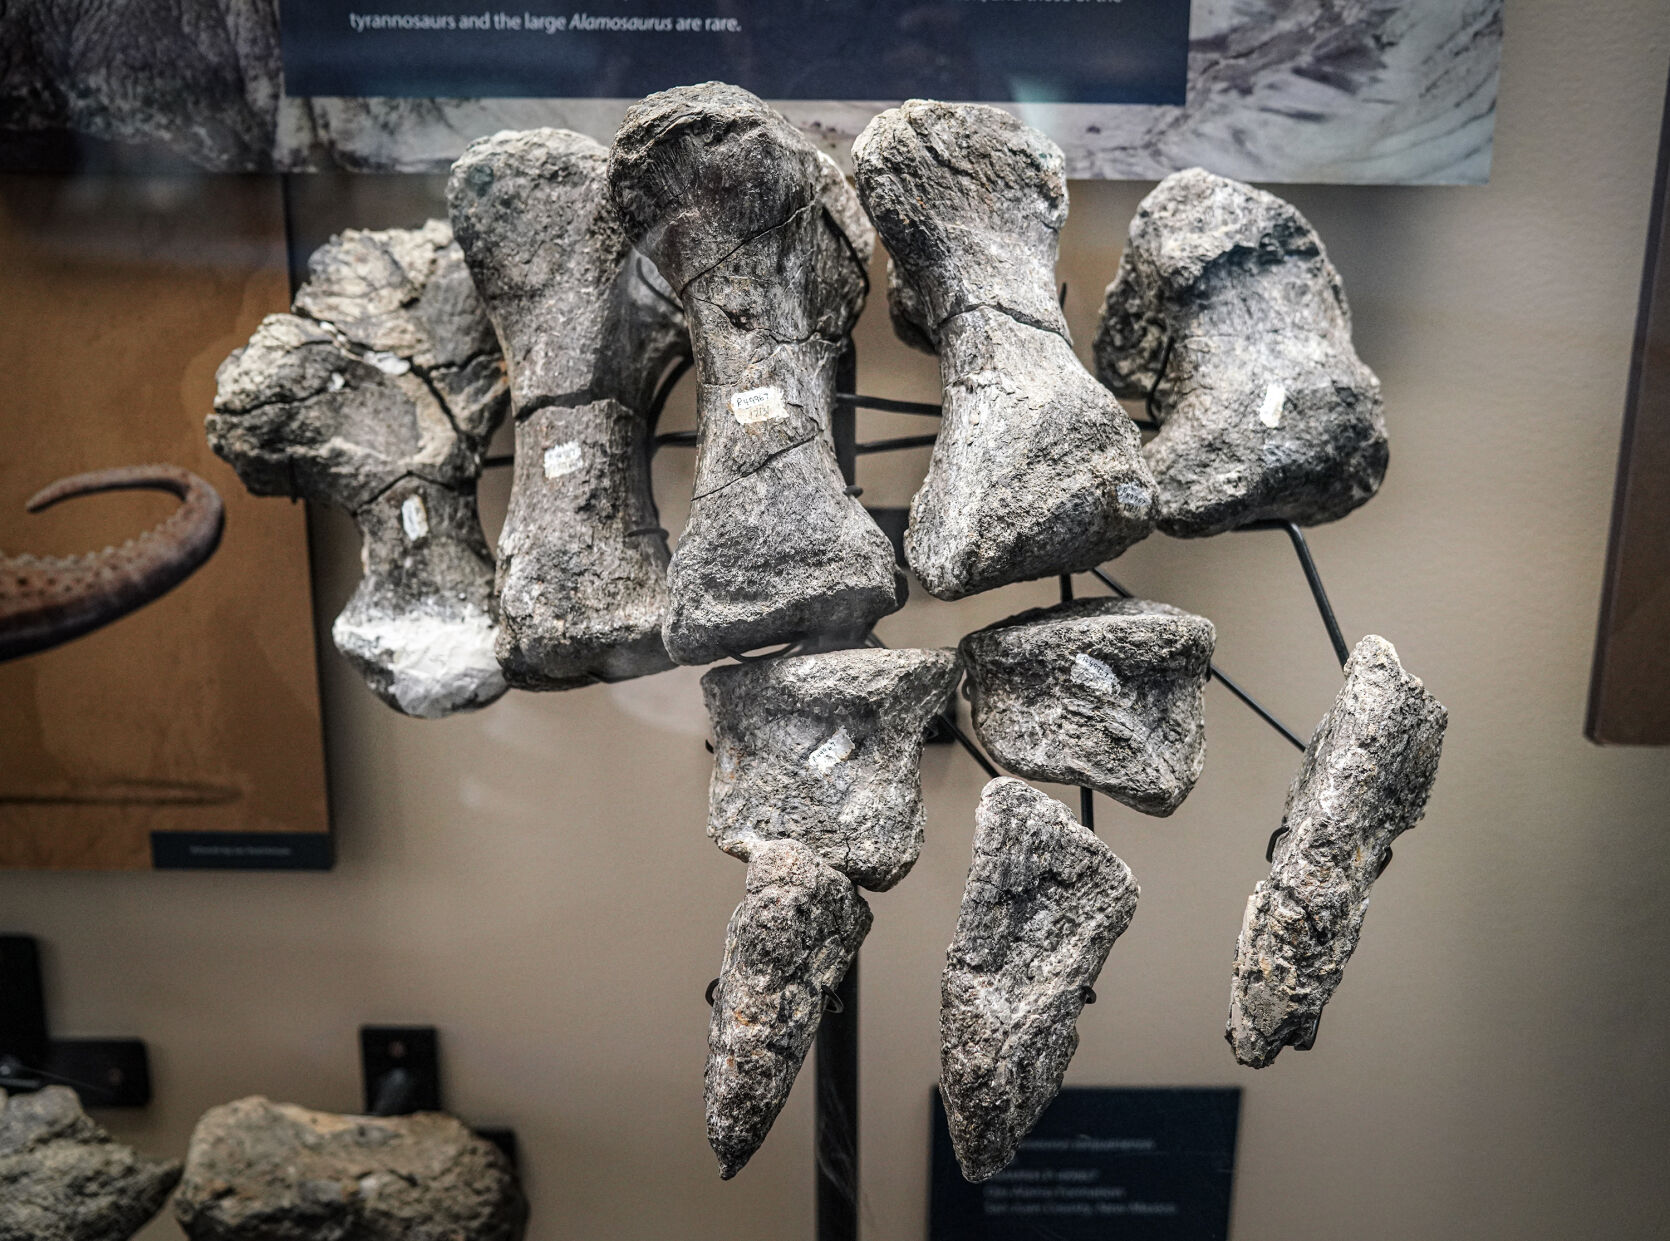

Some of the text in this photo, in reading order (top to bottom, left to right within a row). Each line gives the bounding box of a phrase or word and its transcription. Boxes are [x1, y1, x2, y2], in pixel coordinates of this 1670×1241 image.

[350, 11, 742, 34] tyrannosaurs and the large Alamosaurus are rare.
